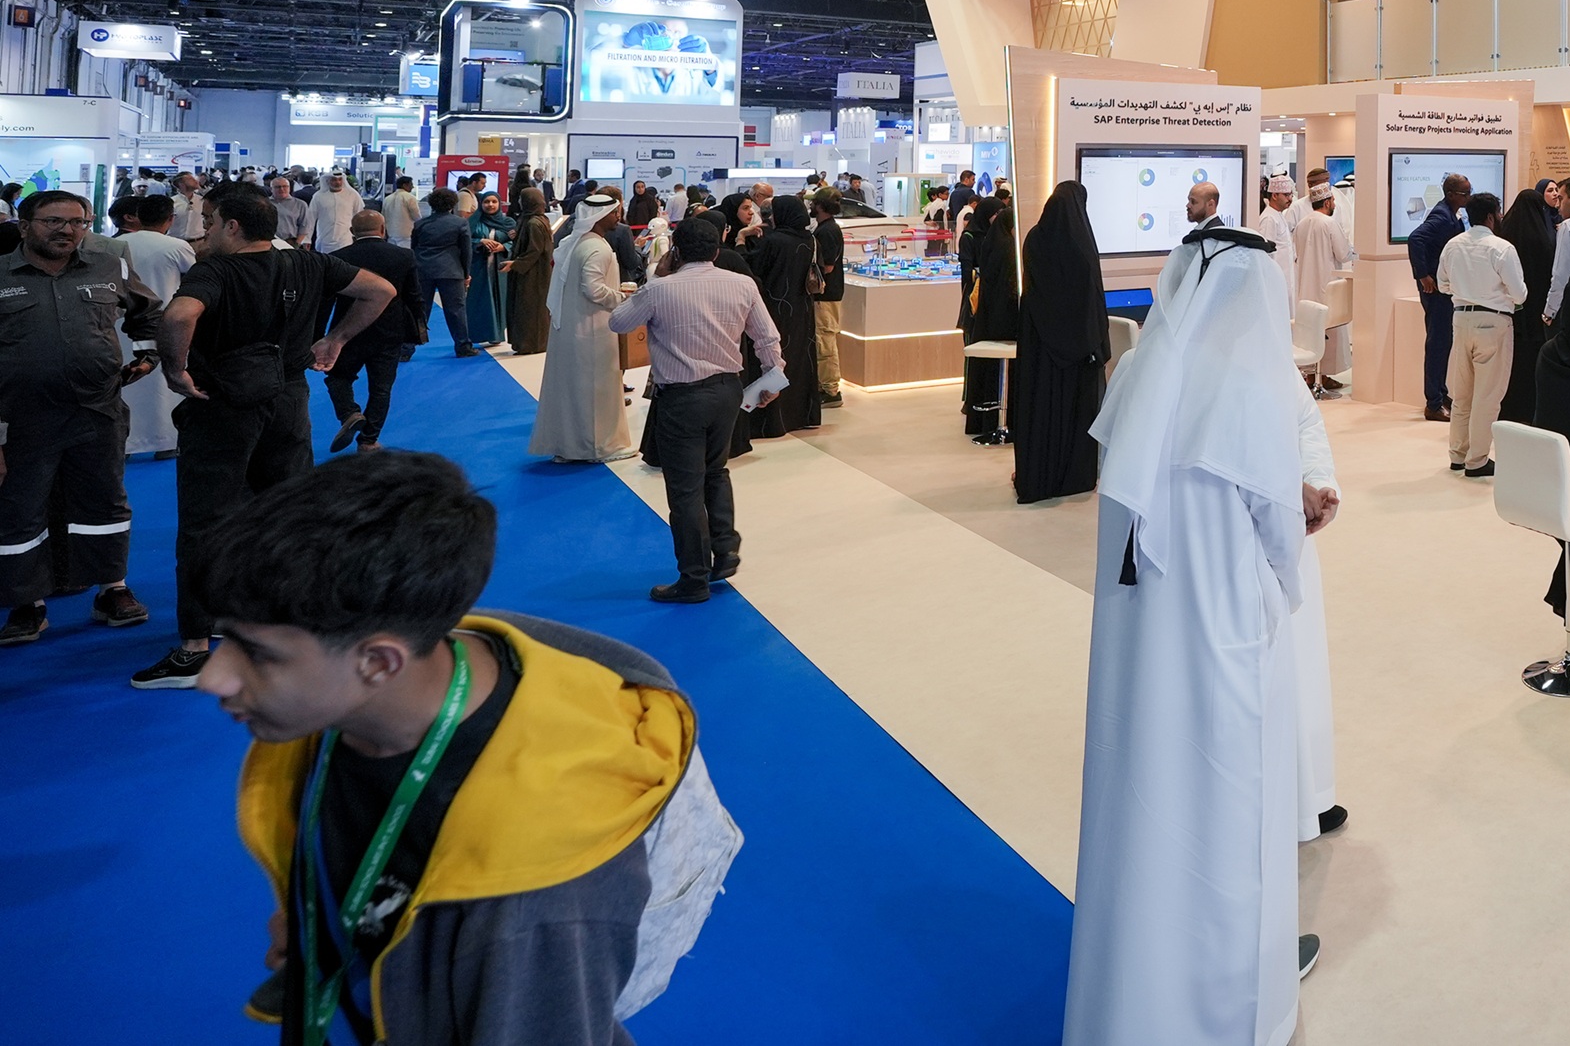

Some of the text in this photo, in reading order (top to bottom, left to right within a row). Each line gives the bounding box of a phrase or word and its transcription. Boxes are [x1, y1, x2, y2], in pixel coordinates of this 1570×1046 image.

[607, 53, 712, 64] FILTRATION AND MICRO FILTRATION
[857, 80, 894, 91] ITALIA
[1117, 100, 1158, 111] التهديدات
[1160, 101, 1187, 110] لكشف
[1203, 102, 1214, 113] إيه
[1235, 103, 1252, 115] نظام
[1094, 115, 1232, 127] SAP Enterprise Threat Detection
[1398, 109, 1502, 124] تطبيق فواتير مشاريع الطاقة الشمسية
[842, 121, 866, 139] ITALIA
[1386, 124, 1513, 136] Solar Energy Projects Invoicing Application
[504, 138, 515, 146] E4
